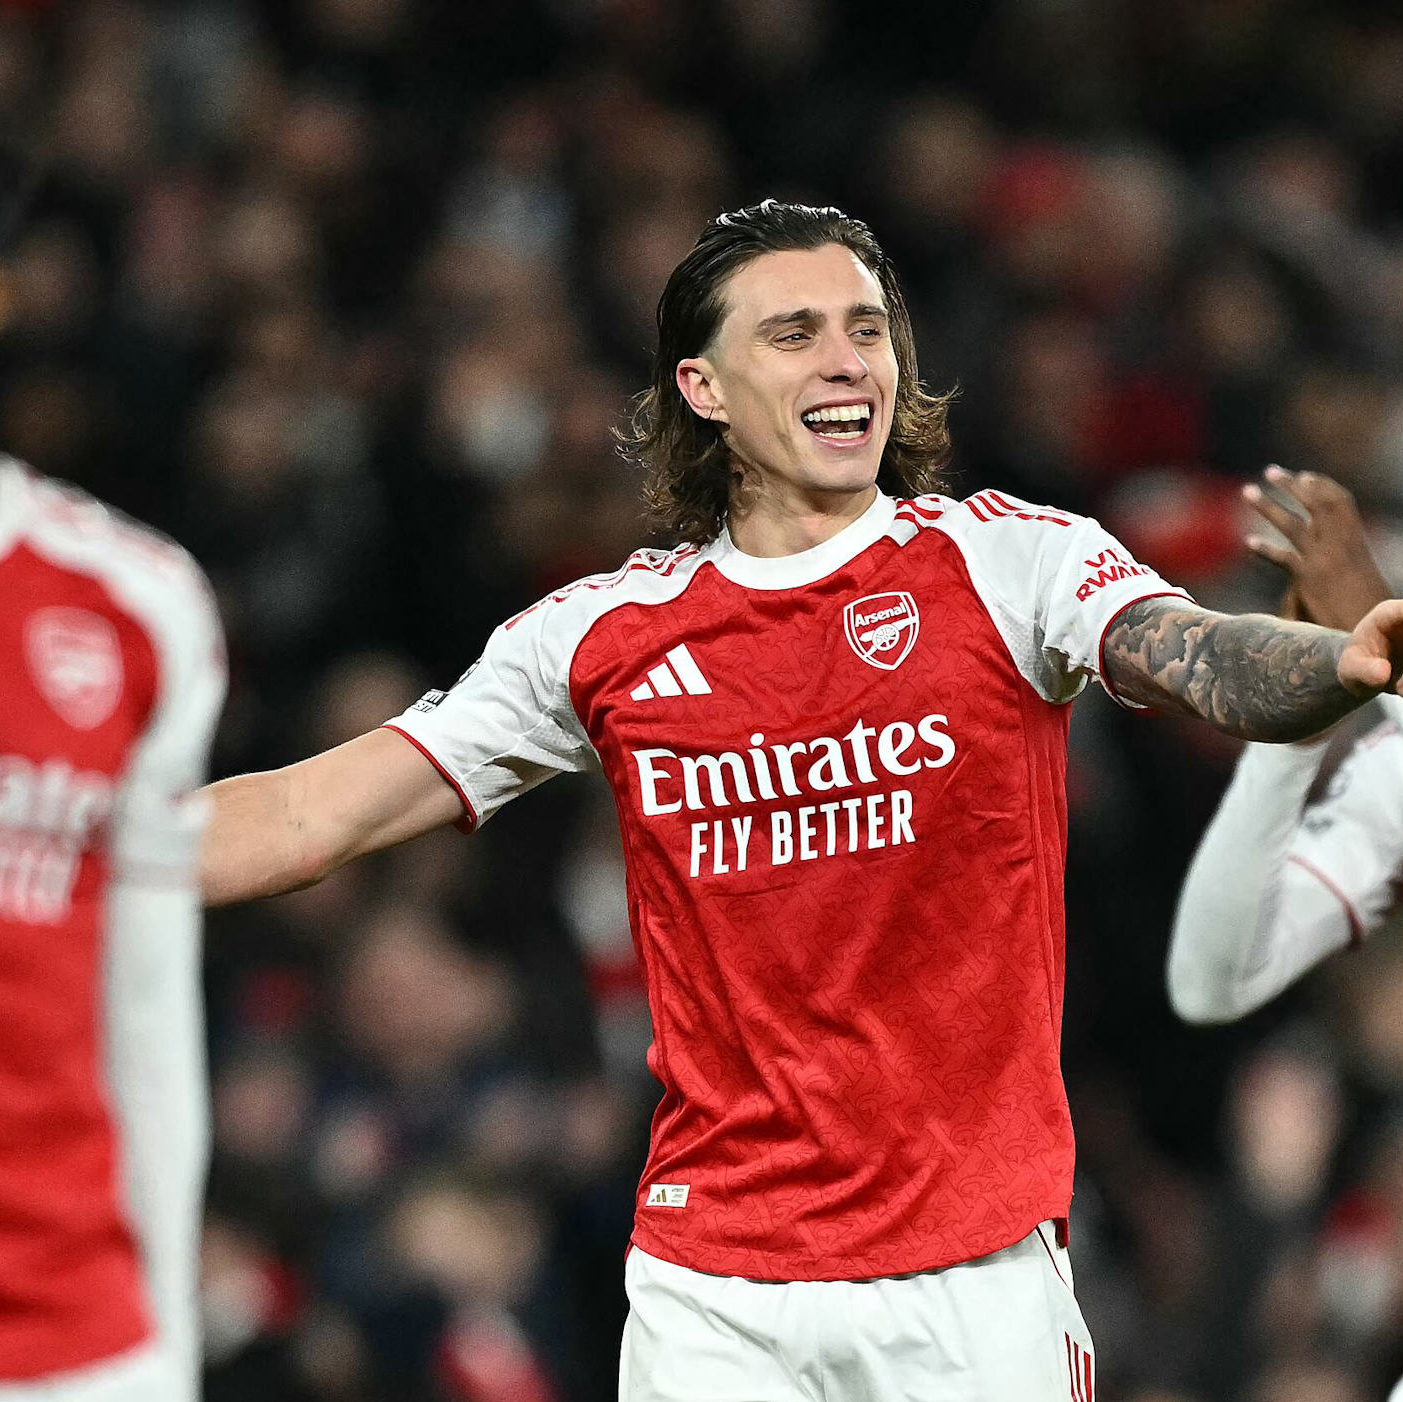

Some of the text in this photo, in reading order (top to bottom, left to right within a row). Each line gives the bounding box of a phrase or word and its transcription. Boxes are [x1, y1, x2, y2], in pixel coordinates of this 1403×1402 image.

[855, 602, 907, 628] Arsenal
[630, 713, 956, 817] Emirates
[689, 789, 917, 879] FLY BETTER
